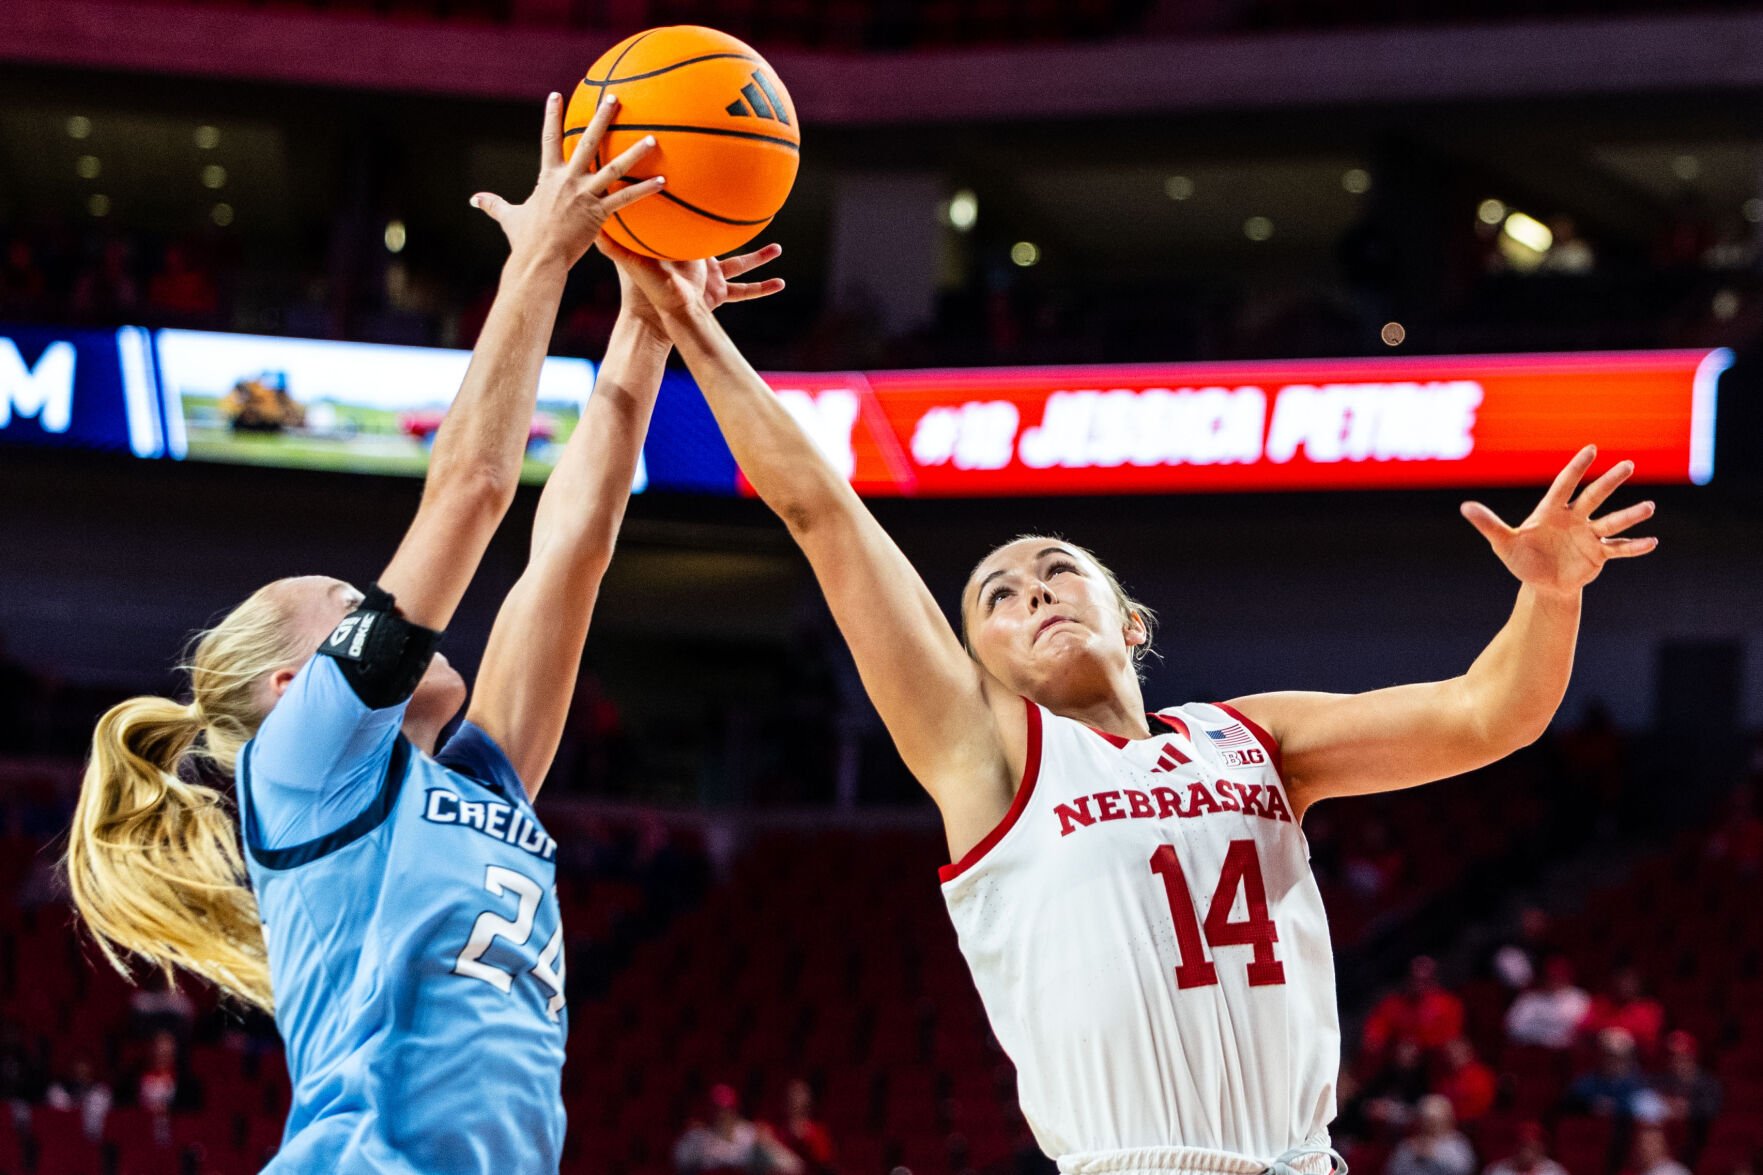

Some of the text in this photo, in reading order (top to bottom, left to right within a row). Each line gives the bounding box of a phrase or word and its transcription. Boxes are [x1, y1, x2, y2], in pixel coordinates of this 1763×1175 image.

[1053, 779, 1292, 837] NEBRASKA
[452, 864, 567, 1024] 24
[1149, 839, 1286, 989] 14
